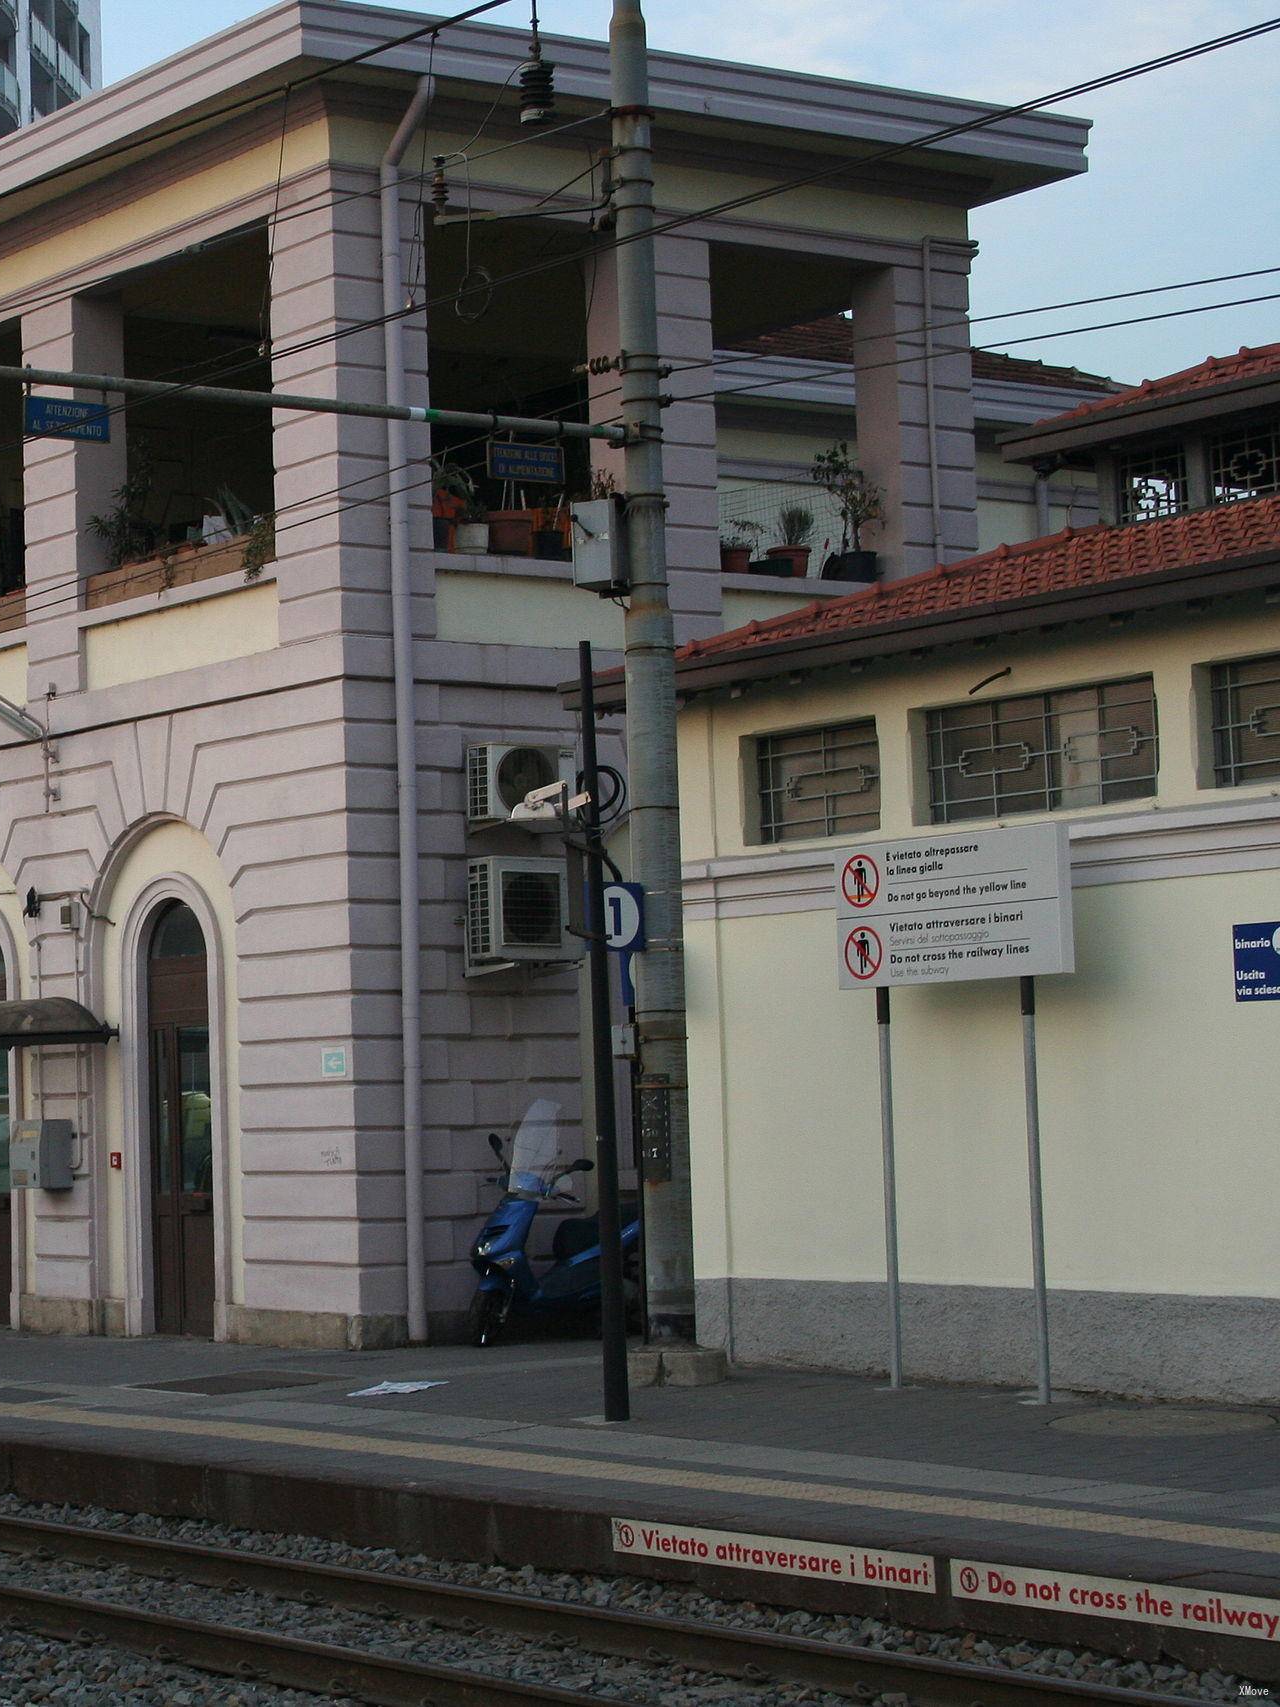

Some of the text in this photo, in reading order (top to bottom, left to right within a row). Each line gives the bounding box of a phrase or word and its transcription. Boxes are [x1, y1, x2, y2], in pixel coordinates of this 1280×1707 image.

[892, 851, 922, 861] vietato
[924, 844, 979, 857] oltrepassare
[886, 861, 943, 876] la linea gialla
[887, 880, 1027, 902] Do not go beyond the yellow line
[609, 897, 622, 936] 1
[889, 922, 923, 932] Vietato
[925, 916, 986, 929] attraversare
[994, 910, 1023, 923] binari
[1234, 937, 1271, 950] binario
[890, 944, 1030, 964] Do not cross the railway lines
[890, 964, 949, 977] Use the subway
[1236, 969, 1266, 981] Uscita
[1236, 985, 1252, 996] via
[640, 1528, 930, 1586] Vietato attraversare i binari
[987, 1571, 1280, 1638] Do not cross the railway
